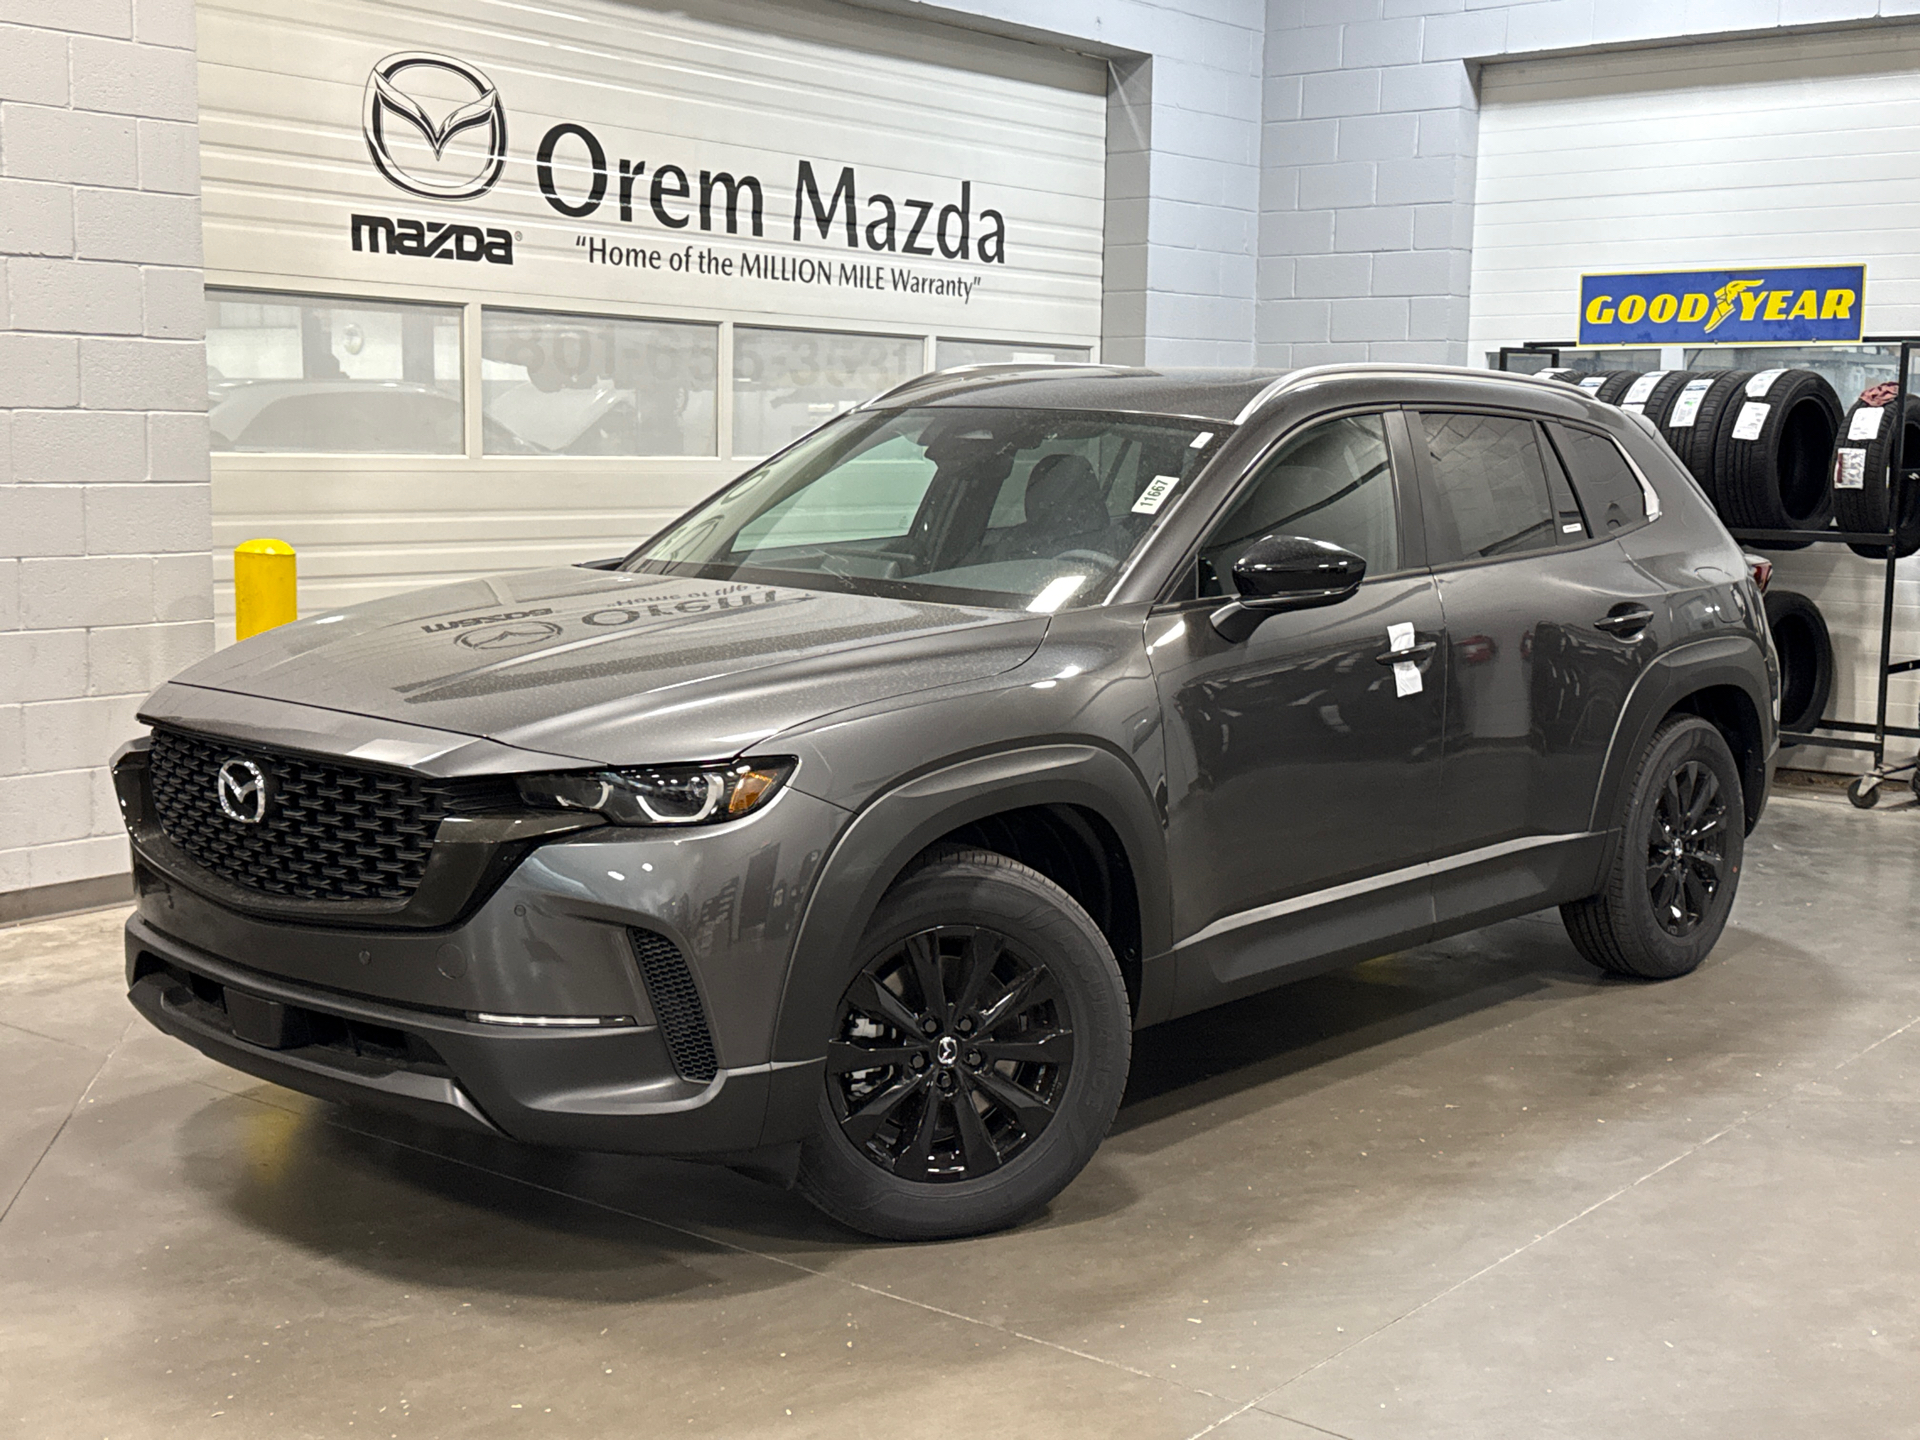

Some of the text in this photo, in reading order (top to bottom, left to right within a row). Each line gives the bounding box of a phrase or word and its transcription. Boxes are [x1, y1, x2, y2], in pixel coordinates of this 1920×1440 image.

[535, 123, 1005, 264] Orem Mazda
[669, 245, 693, 272] of
[698, 248, 733, 276] the
[740, 252, 832, 286] MILLION
[839, 262, 885, 291] MILE
[1139, 479, 1169, 507] 11667
